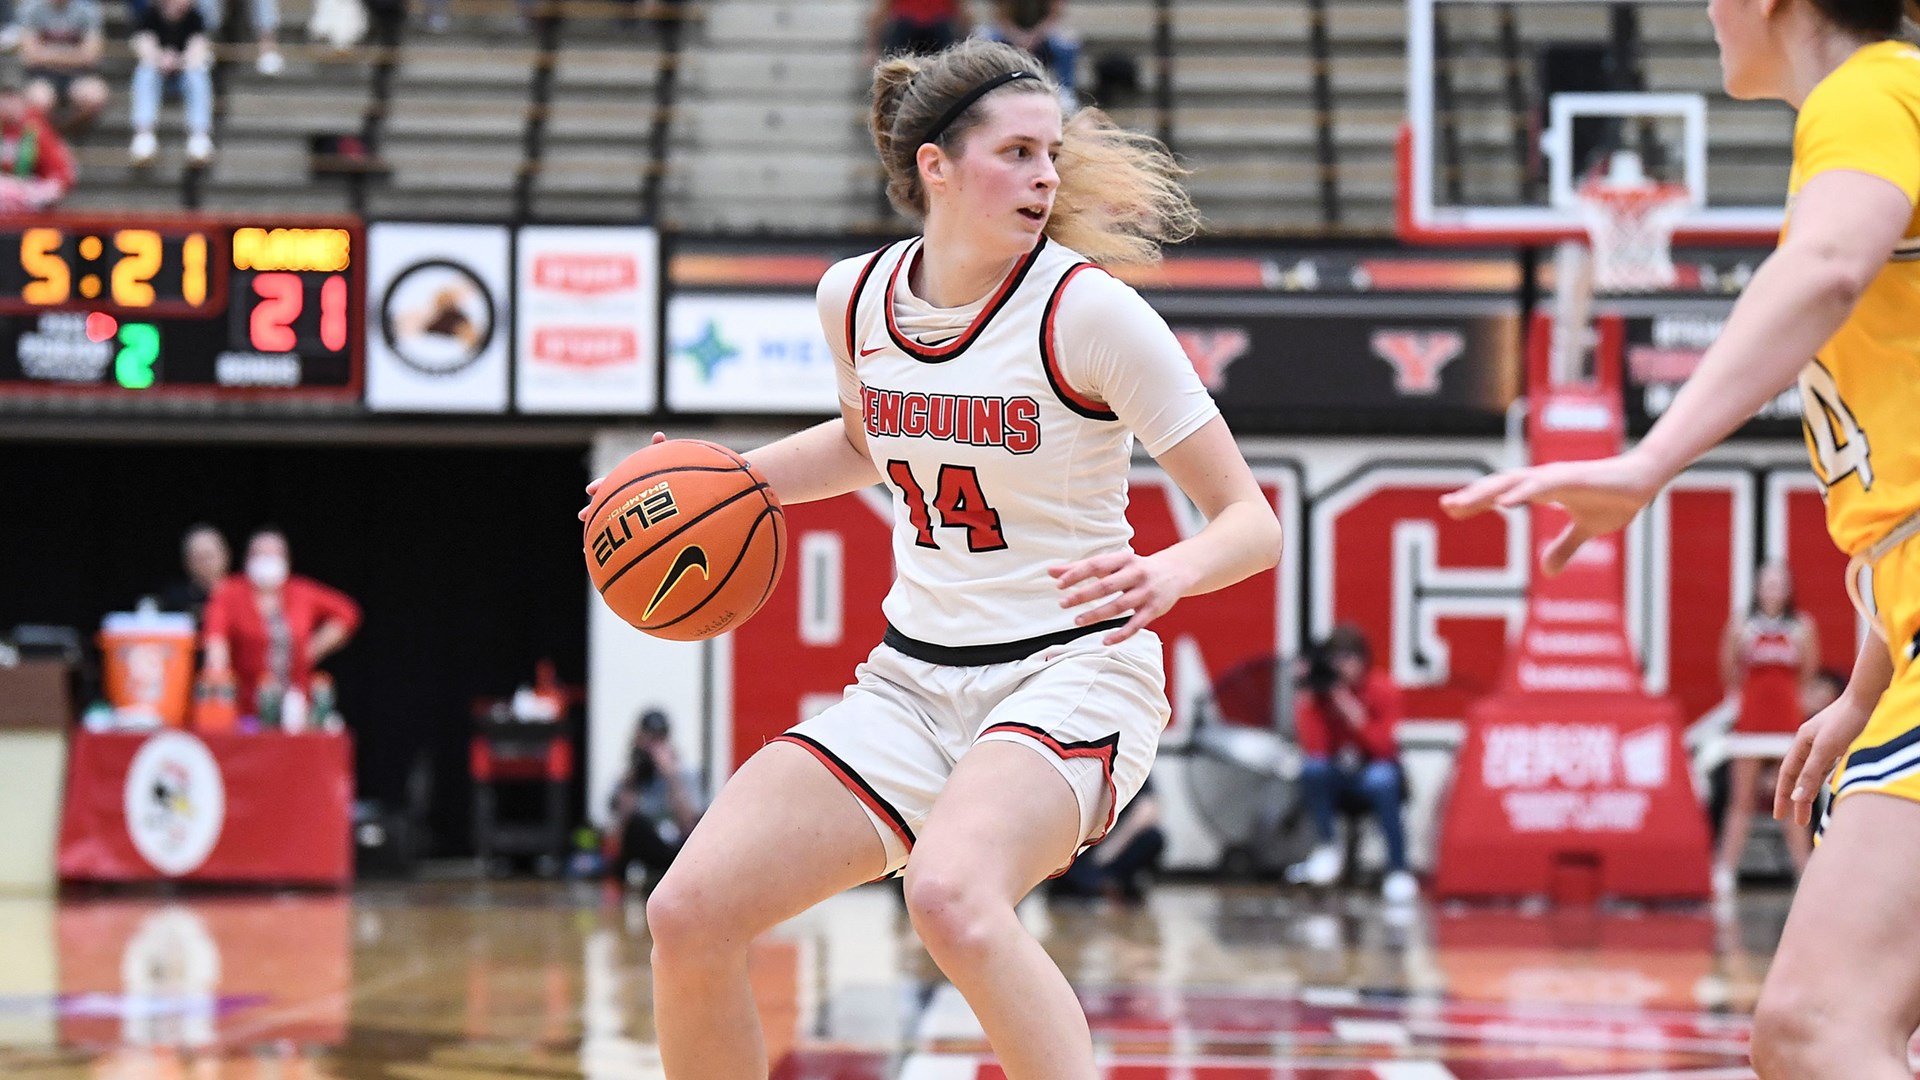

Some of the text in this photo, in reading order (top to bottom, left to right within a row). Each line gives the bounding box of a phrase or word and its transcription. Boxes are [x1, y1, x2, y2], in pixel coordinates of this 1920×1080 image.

[20, 228, 208, 307] 5:21
[250, 273, 348, 352] 21
[115, 323, 161, 389] 2
[592, 488, 680, 568] ELITE
[887, 459, 1008, 552] 14
